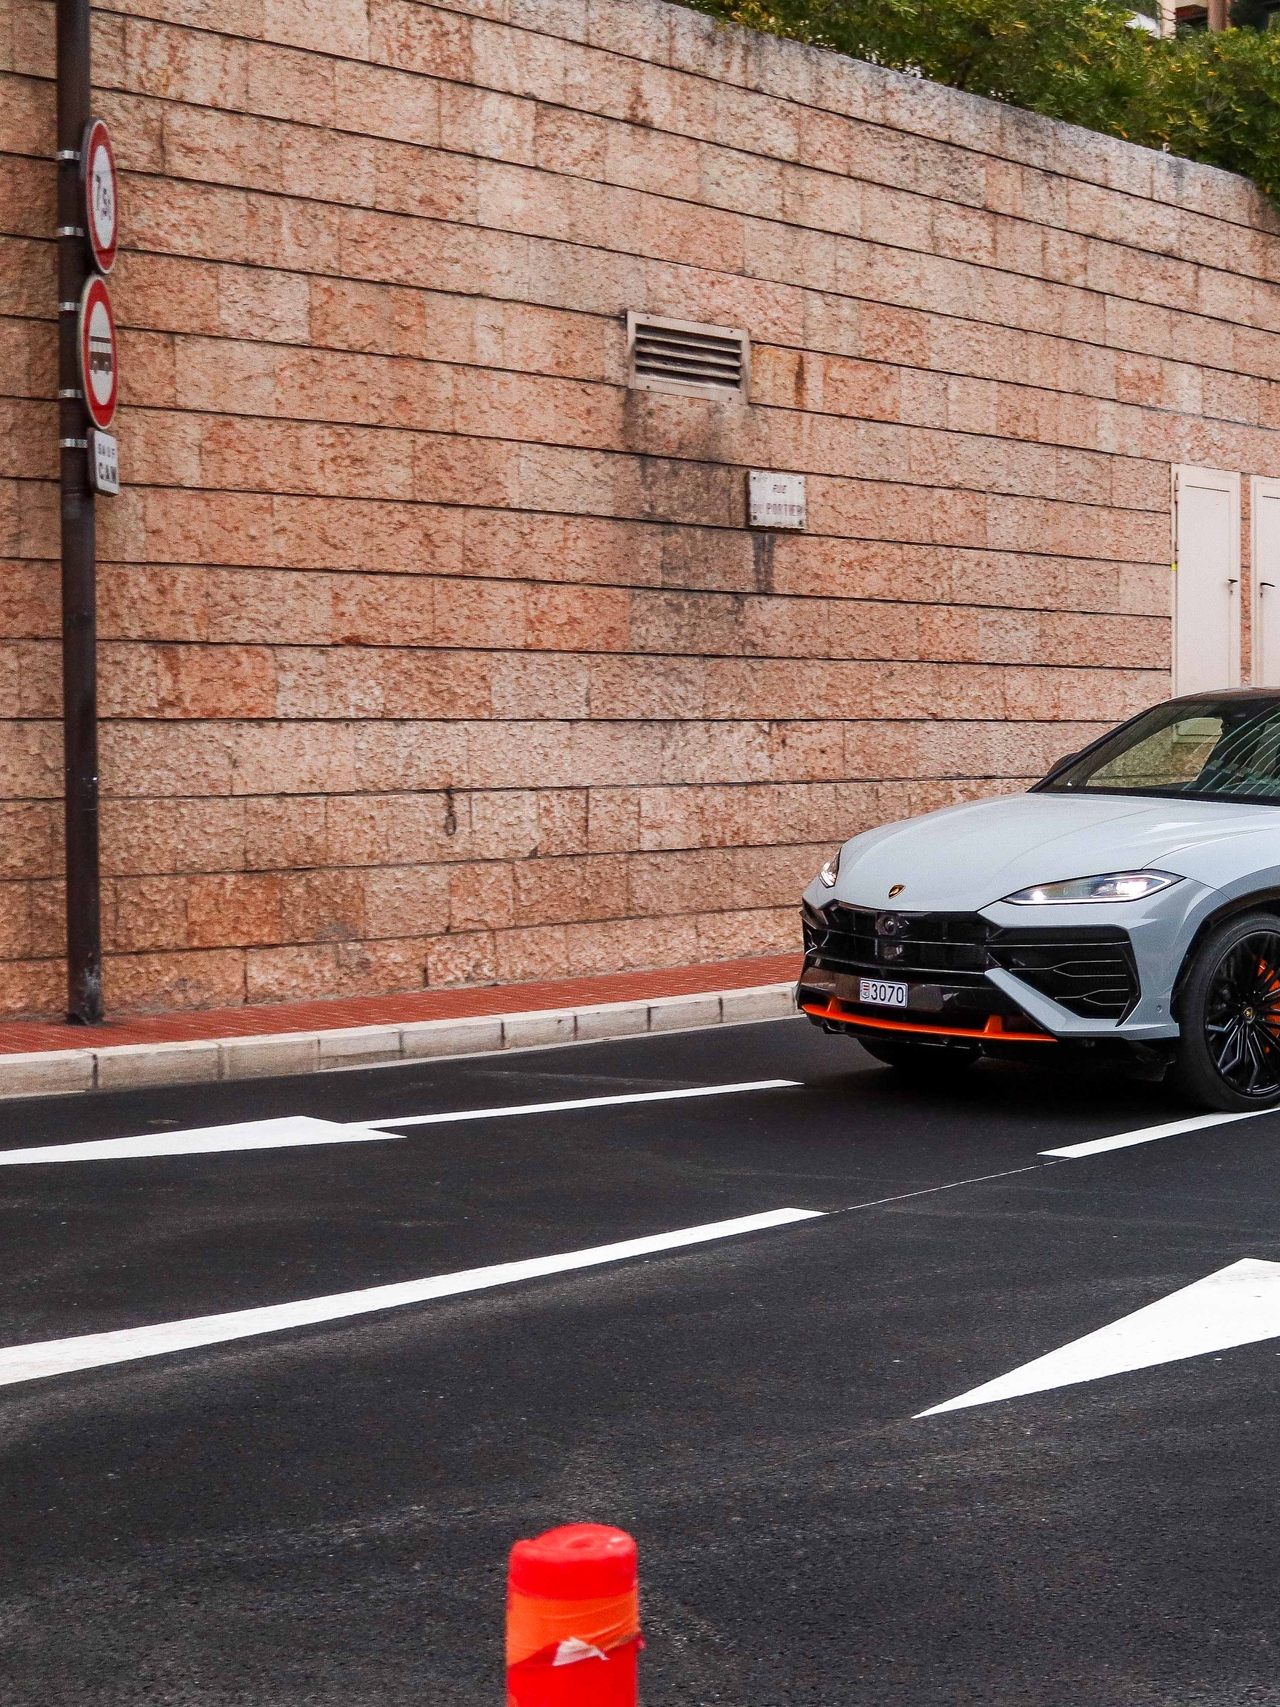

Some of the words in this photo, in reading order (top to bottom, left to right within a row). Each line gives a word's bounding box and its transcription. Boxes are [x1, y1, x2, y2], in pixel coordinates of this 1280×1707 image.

[772, 484, 787, 494] RUE
[766, 503, 804, 516] PORTIER
[871, 983, 904, 1004] 3070
